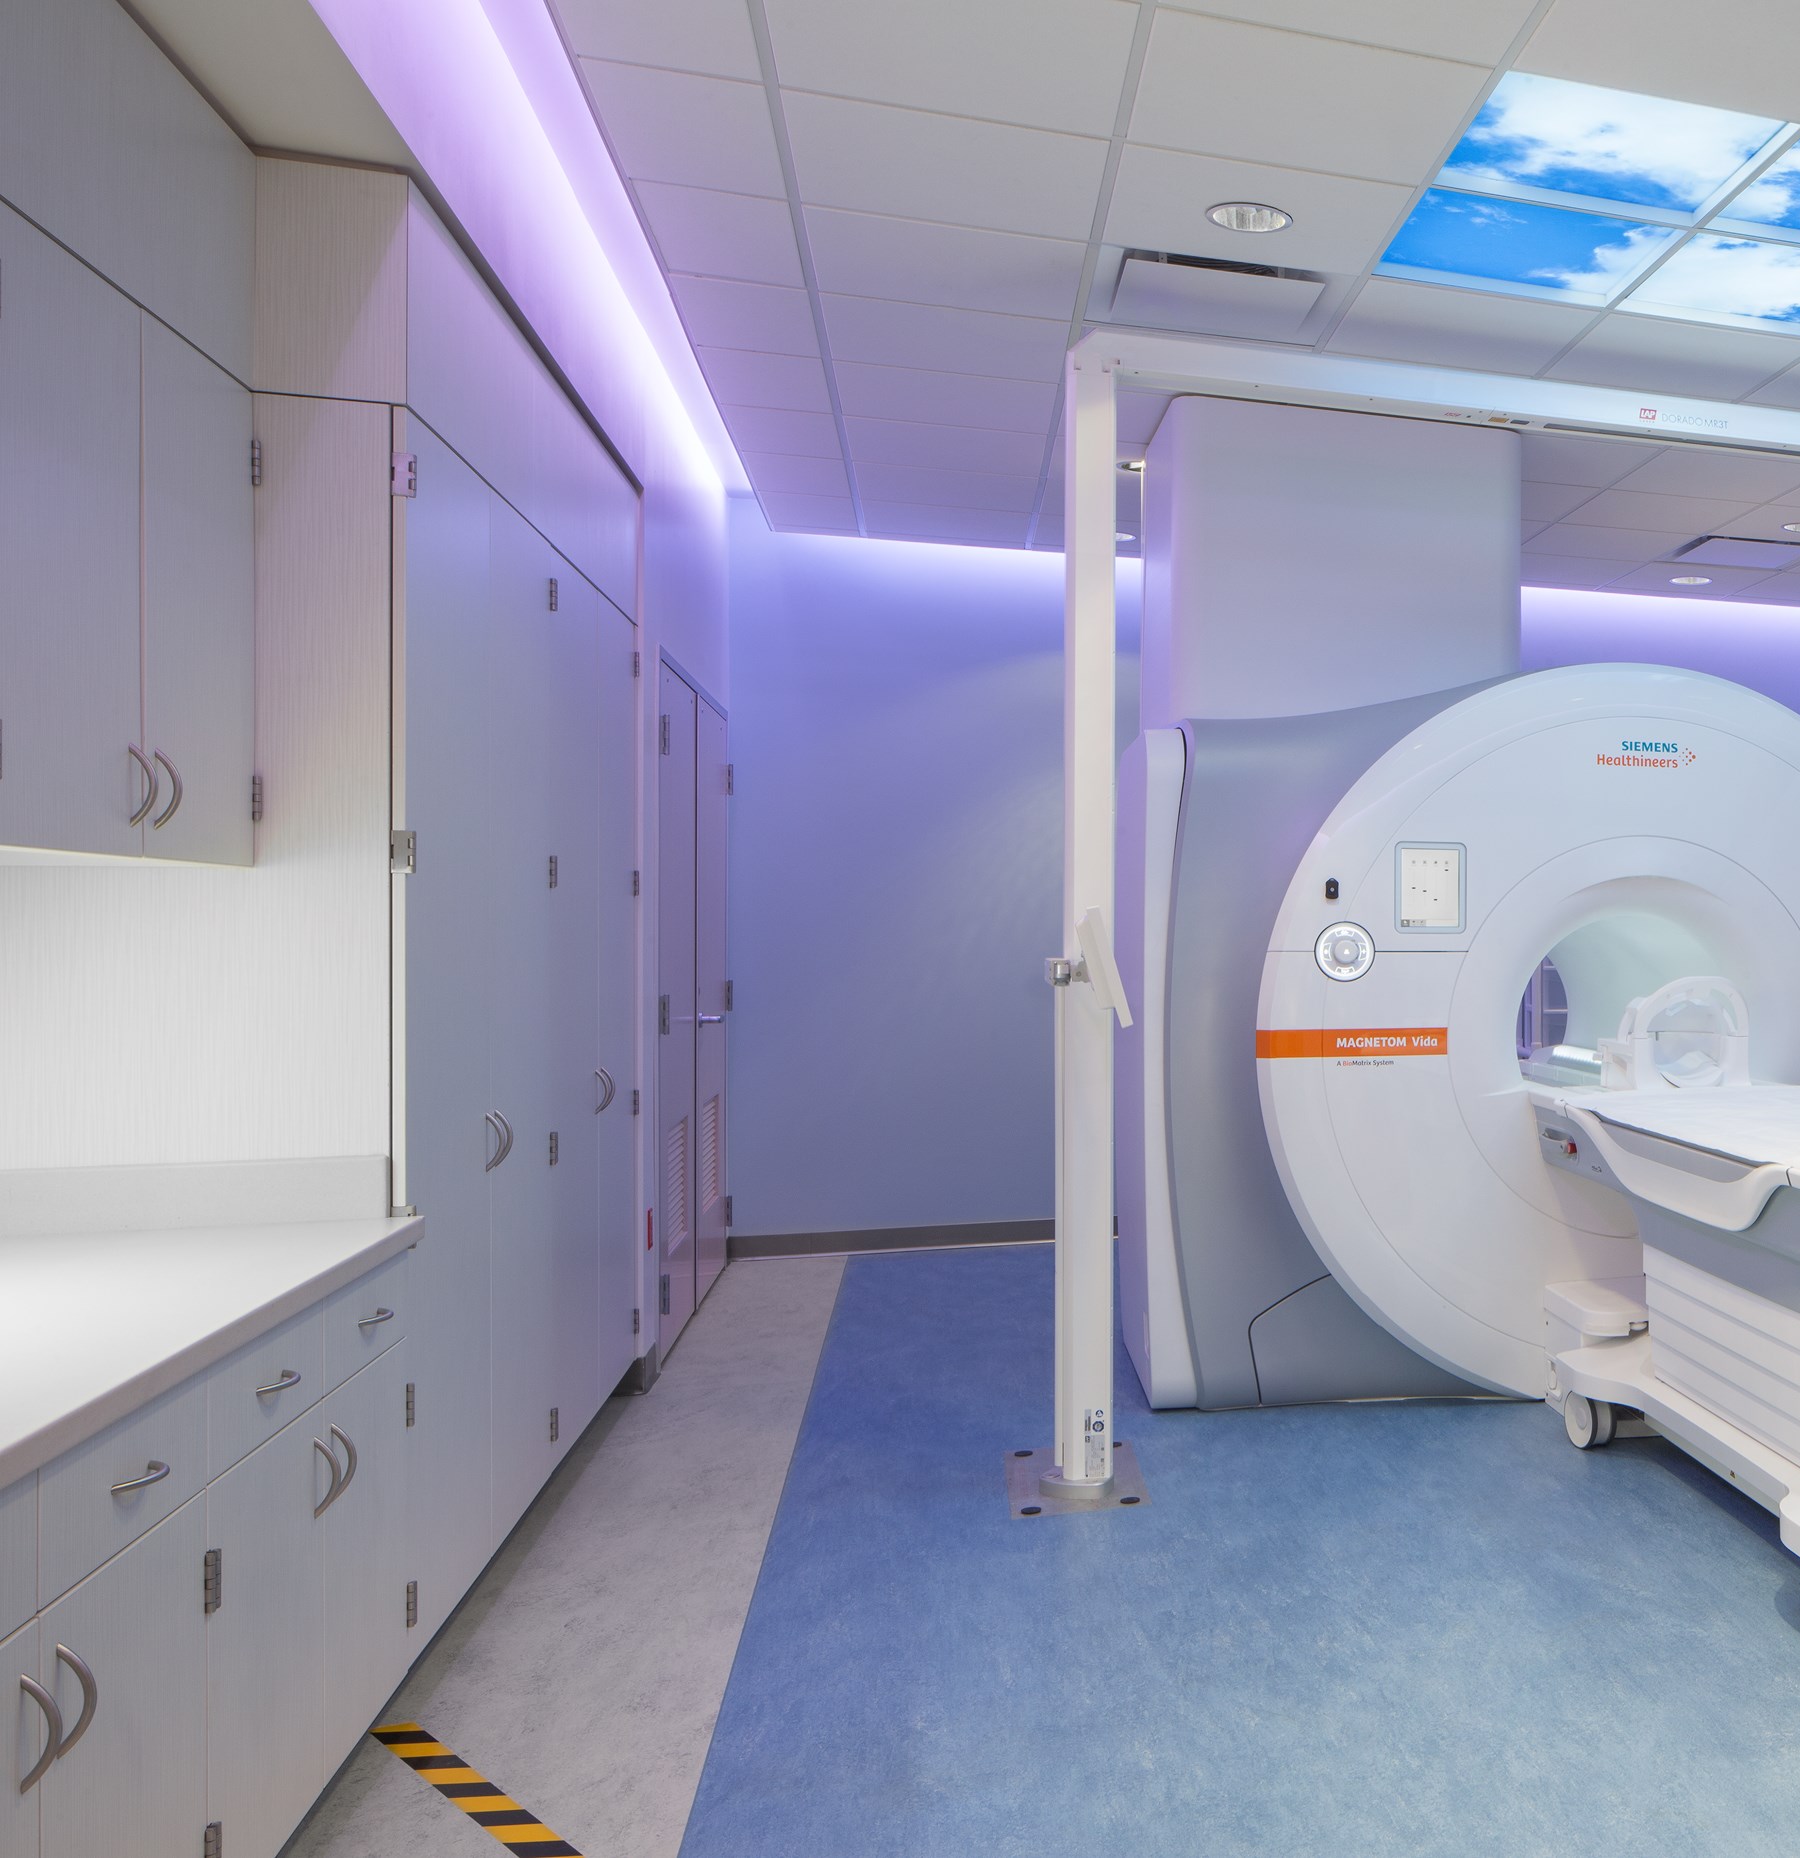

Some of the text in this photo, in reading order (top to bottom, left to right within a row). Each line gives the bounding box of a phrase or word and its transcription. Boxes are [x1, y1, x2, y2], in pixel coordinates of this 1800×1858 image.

[1641, 409, 1656, 419] LAP
[1621, 740, 1678, 753] SIEMENS
[1597, 753, 1678, 768] Healthineers
[1336, 1036, 1438, 1048] MAGNETOM Vida
[1372, 1059, 1395, 1068] System
